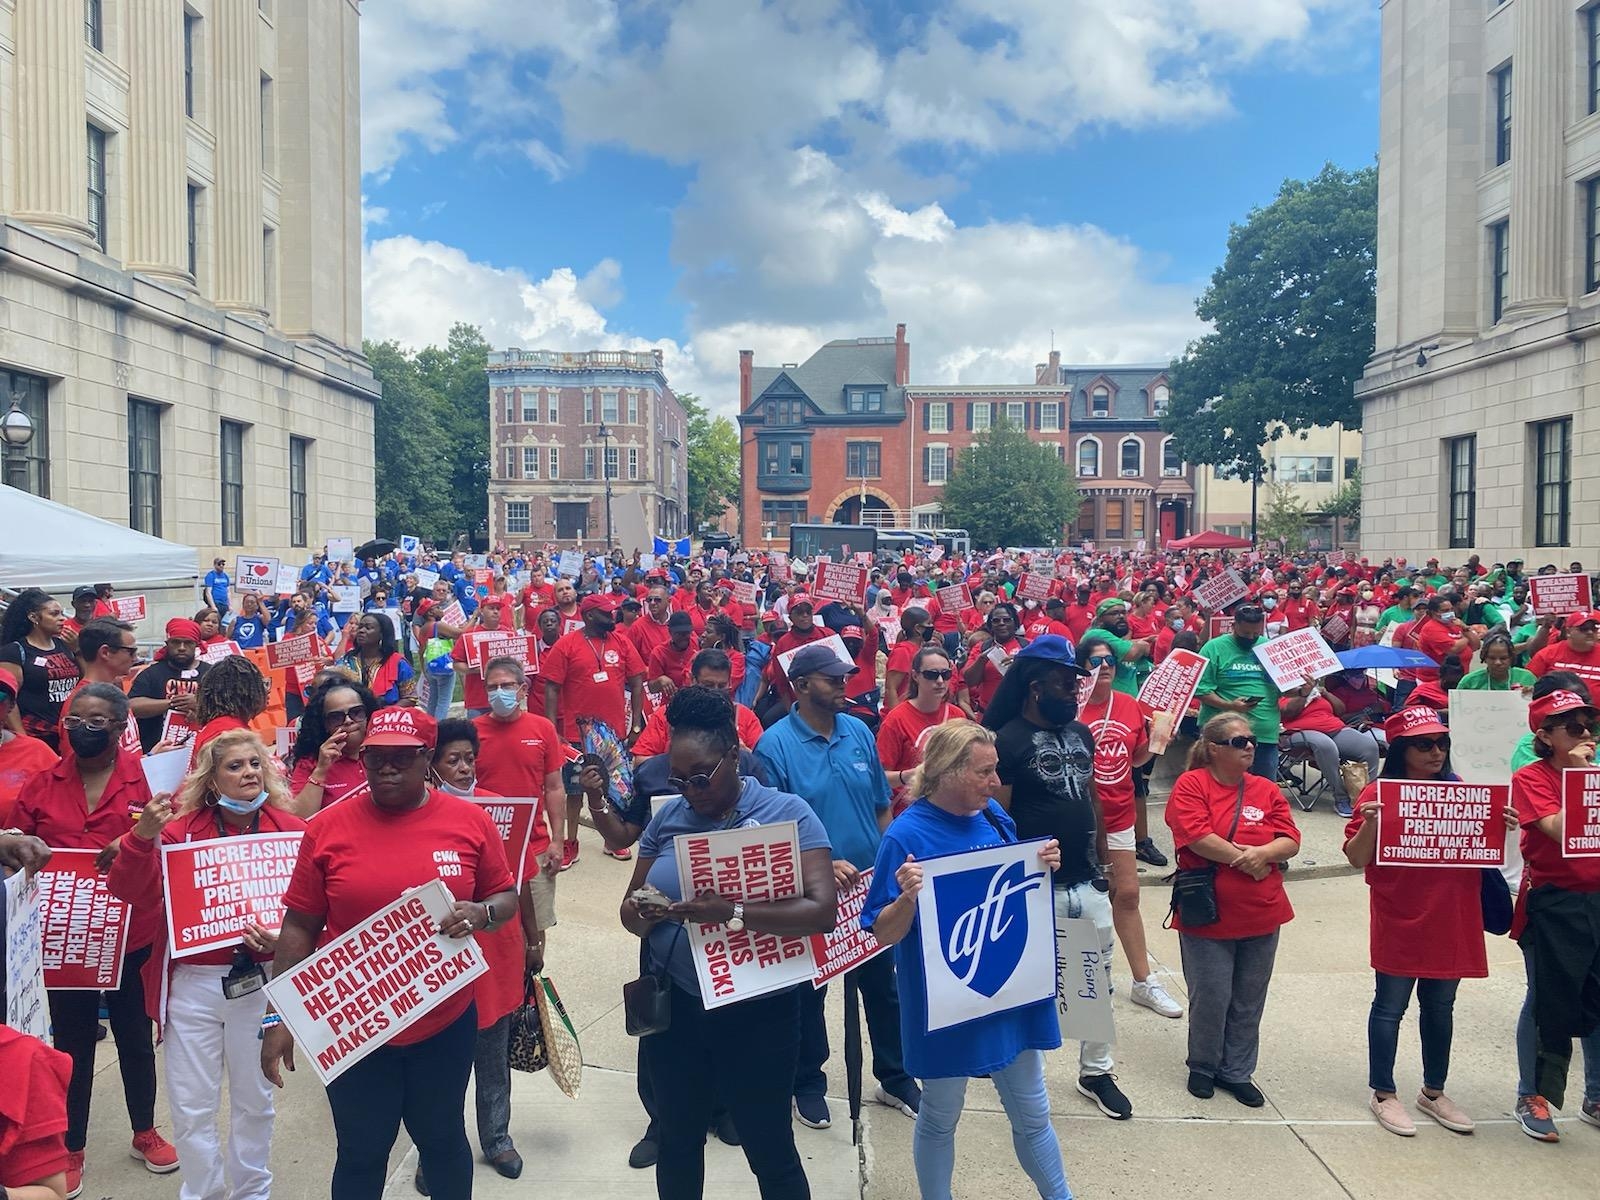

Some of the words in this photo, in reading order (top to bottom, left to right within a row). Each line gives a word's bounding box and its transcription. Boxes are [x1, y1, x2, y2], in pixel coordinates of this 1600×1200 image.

[240, 575, 273, 585] RUnions
[245, 564, 254, 576] I
[823, 571, 860, 584] HEALTHCARE
[825, 564, 860, 576] INCREASING
[825, 578, 857, 590] PREMIUMS
[1208, 584, 1238, 605] PREMIUMS
[488, 638, 528, 649] INCREASING
[488, 645, 529, 657] HEALTHCARE
[1264, 632, 1314, 656] INCREASING
[1269, 641, 1320, 666] HEALTHCARE
[1183, 664, 1192, 676] NJ
[1279, 650, 1324, 673] PREMIUMS
[1304, 665, 1318, 674] ME
[1318, 657, 1336, 669] SICK!
[48, 676, 80, 693] UNION
[1148, 658, 1179, 708] HEALTHCARE
[1158, 664, 1185, 709] PREMIUMS
[372, 711, 414, 725] CWA
[1403, 707, 1435, 721] CWA
[1094, 741, 1129, 757] WA
[1400, 785, 1491, 803] INCREASING
[1399, 802, 1492, 819] HEALTHCARE
[1404, 819, 1484, 836] PREMIUMS
[1383, 846, 1440, 859] STRONGER
[1443, 848, 1457, 859] OR
[1460, 849, 1501, 860] FAIRER!
[1400, 835, 1435, 847] WON'T
[1438, 836, 1469, 848] MAKE
[1472, 838, 1486, 848] NJ
[432, 850, 461, 863] CWA
[193, 859, 298, 889] HEALTHCAR
[203, 877, 292, 907] PREMIUM
[768, 841, 804, 961] INCRENG
[90, 894, 109, 929] MAKE
[106, 906, 122, 923] OR
[201, 900, 247, 922] WON'T
[252, 895, 288, 912] MAK
[741, 844, 782, 969] HEALTARE
[43, 871, 77, 970] HEALTHCARE
[64, 878, 96, 964] PREMIUMS
[181, 913, 257, 943] STRONGER
[262, 910, 280, 925] OR
[948, 861, 1045, 983] aft
[824, 919, 862, 948] PREM
[84, 931, 102, 968] WON'T
[97, 926, 119, 984] STRONGER
[291, 897, 426, 997] INCREASING
[817, 944, 865, 979] STRONGER
[865, 935, 878, 951] OR
[825, 935, 854, 961] WON'T
[303, 915, 438, 1021] HEALTHCARE
[704, 940, 735, 998] SICK!
[1078, 951, 1100, 1000] Rising
[326, 942, 443, 1036] PREMIUMS
[317, 1011, 390, 1071] MAKES
[390, 985, 424, 1018] ME
[424, 948, 476, 994] SICK!
